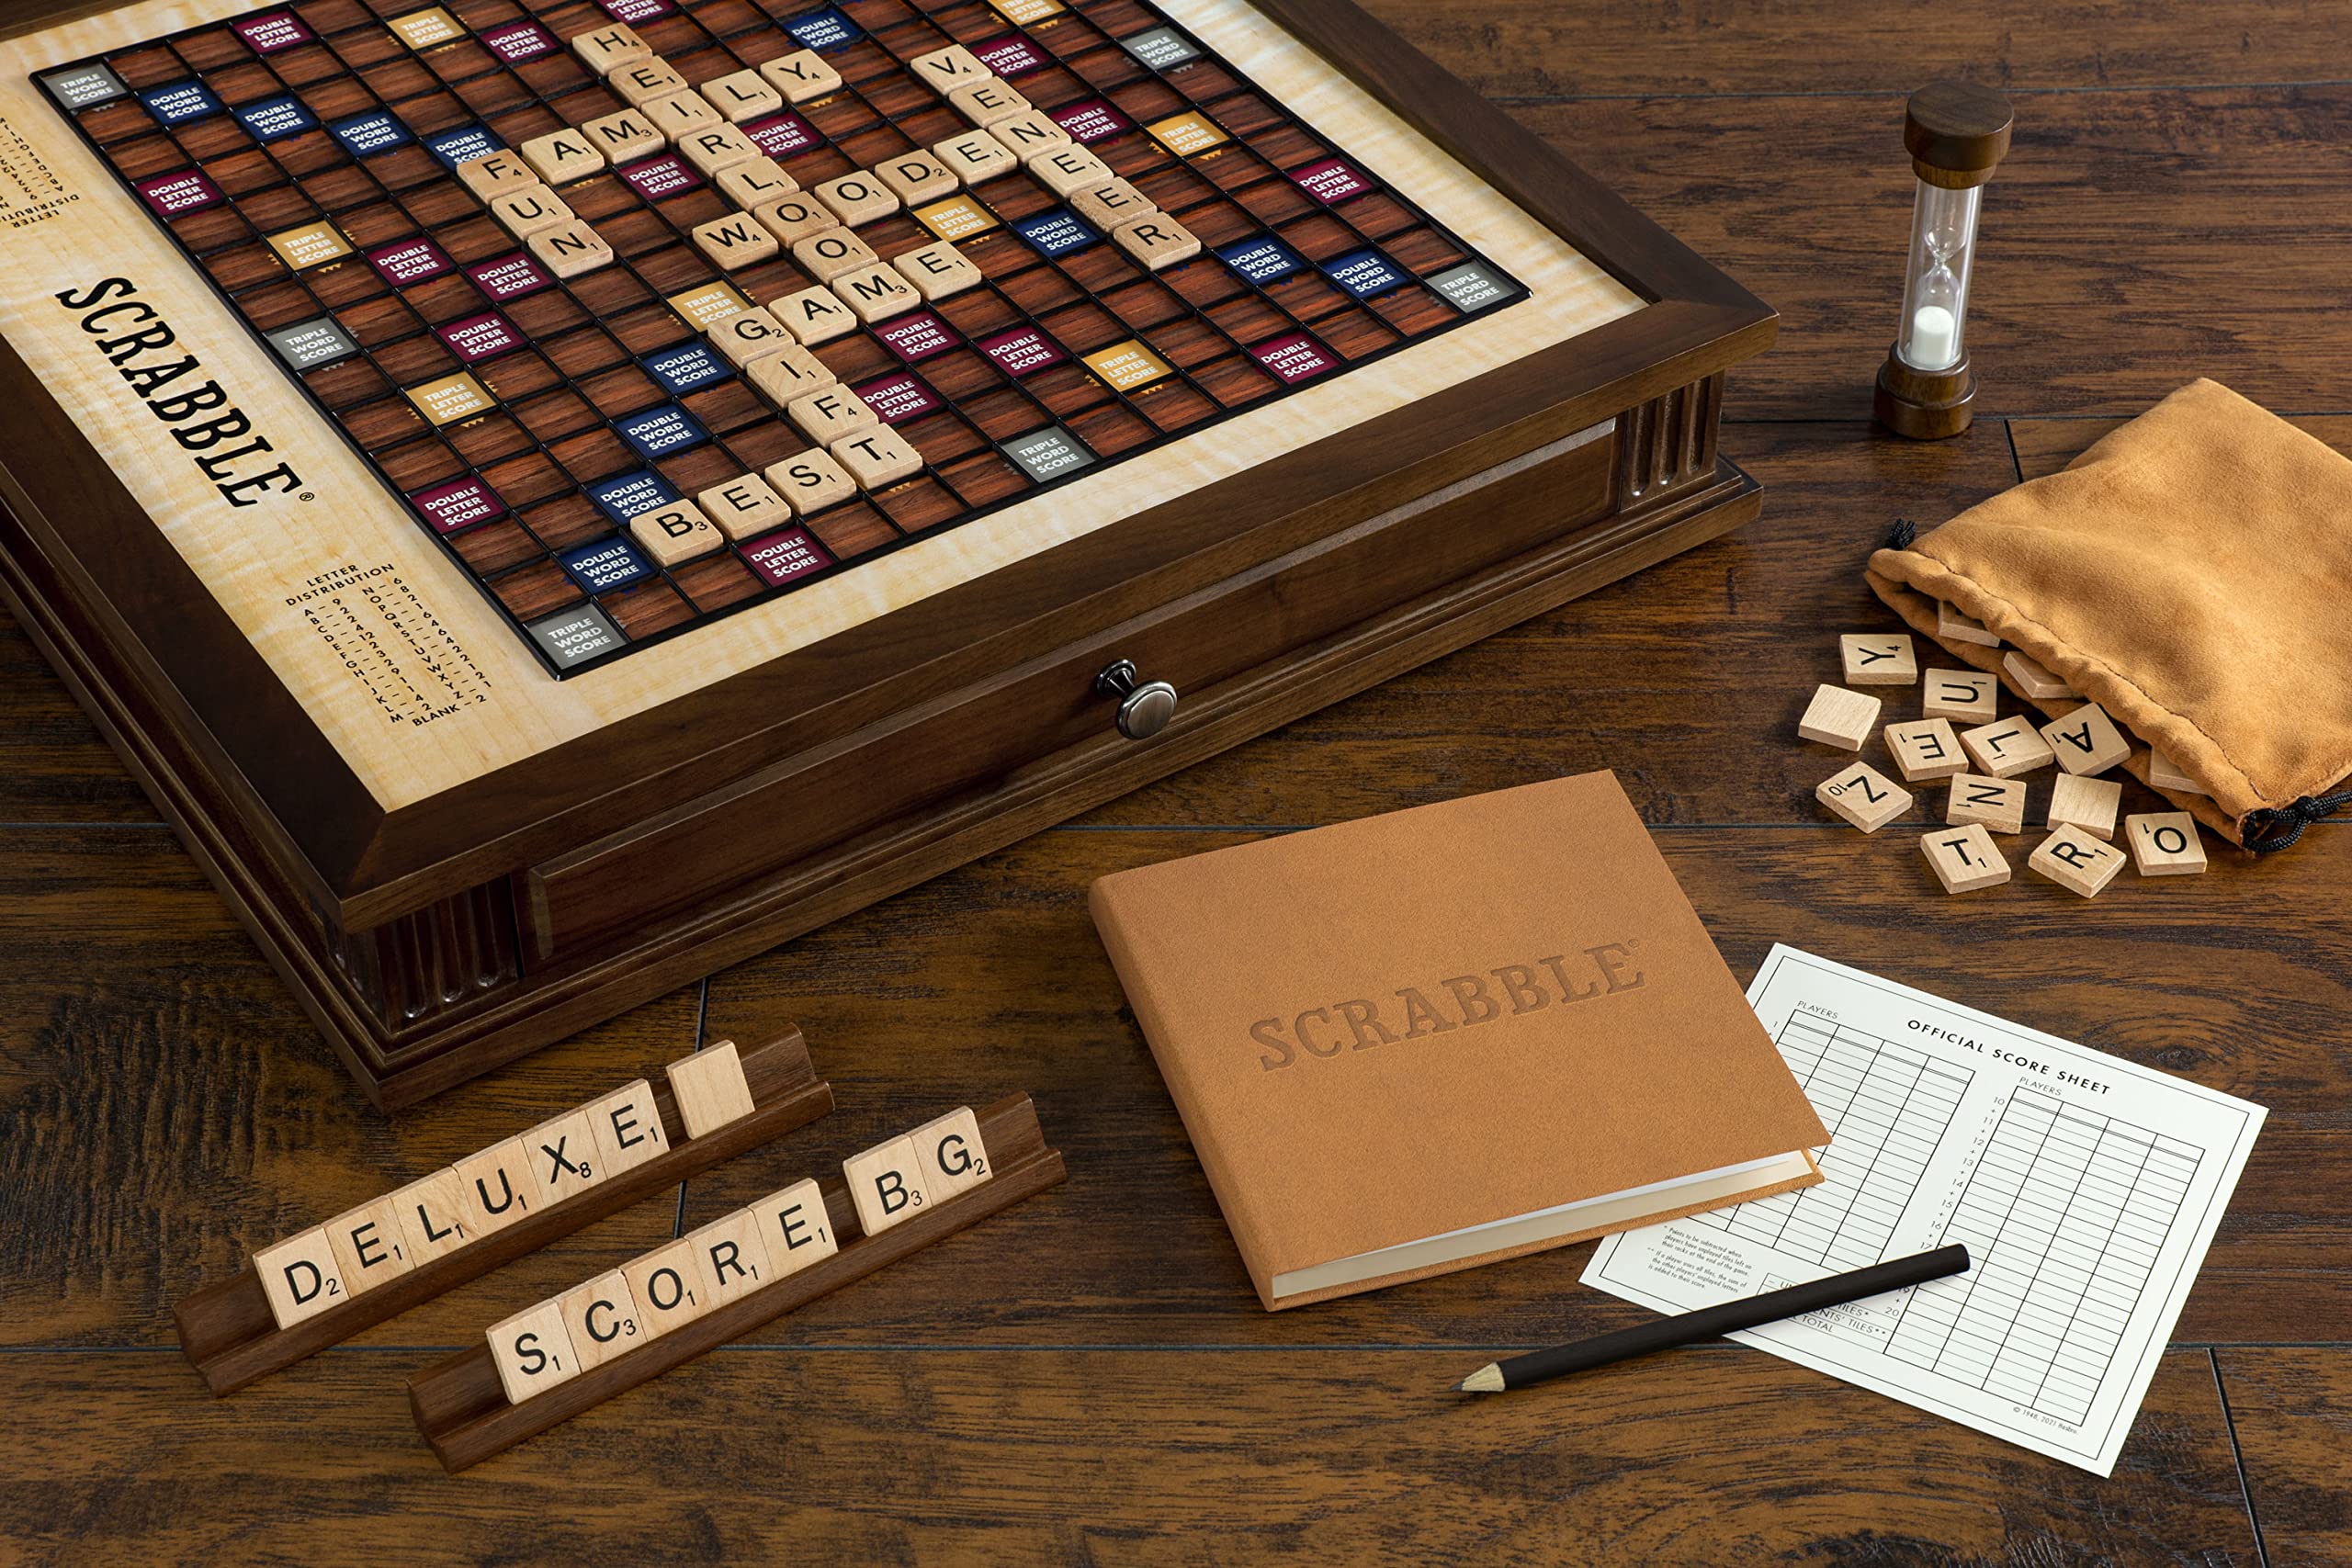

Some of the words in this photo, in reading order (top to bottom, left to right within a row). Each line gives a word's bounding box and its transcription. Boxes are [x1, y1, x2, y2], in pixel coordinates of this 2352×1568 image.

[243, 18, 291, 35] DOUBLE
[254, 26, 294, 40] LETTER
[791, 17, 837, 35] DOUBLE
[802, 25, 841, 39] WORD
[261, 31, 300, 47] SCORE
[810, 31, 848, 47] SCORE
[1135, 36, 1171, 51] TRIPLE
[980, 42, 1025, 62] DOUBLE
[991, 51, 1029, 67] LETTER
[1142, 42, 1180, 58] WORD
[1151, 49, 1188, 65] SCORE
[1000, 56, 1037, 73] SCORE
[60, 74, 100, 88] TRIPLE
[64, 80, 107, 96] WORD
[72, 86, 113, 103] SCORE
[150, 87, 199, 106] DOUBLE
[159, 96, 201, 111] WORD
[166, 102, 209, 118] SCORE
[244, 102, 294, 121] DOUBLE
[254, 111, 296, 127] WORD
[262, 118, 303, 134] SCORE
[1299, 165, 1346, 186] DOUBLE
[1312, 174, 1351, 192] LETTER
[148, 176, 199, 197] DOUBLE
[159, 186, 201, 202] LETTER
[1321, 180, 1360, 198] SCORE
[165, 192, 209, 209] SCORE
[11, 209, 60, 228] LETTER
[930, 205, 968, 221] TRIPLE
[937, 212, 977, 230] LETTER
[945, 219, 986, 236] SCORE
[378, 244, 429, 265] DOUBLE
[389, 254, 431, 271] LETTER
[396, 260, 439, 278] SCORE
[477, 259, 528, 280] DOUBLE
[1332, 257, 1379, 278] DOUBLE
[1344, 266, 1385, 285] WORD
[489, 268, 531, 287] LETTER
[496, 275, 538, 294] SCORE
[1354, 273, 1395, 292] SCORE
[1441, 272, 1479, 290] TRIPLE
[1449, 279, 1489, 298] WORD
[1460, 287, 1499, 305] SCORE
[286, 328, 328, 345] TRIPLE
[291, 335, 335, 353] WORD
[300, 343, 343, 361] SCORE
[653, 349, 707, 371] DOUBLE
[665, 358, 708, 378] WORD
[674, 366, 718, 385] SCORE
[424, 383, 467, 401] TRIPLE
[431, 391, 474, 410] LETTER
[863, 380, 914, 403] DOUBLE
[876, 389, 919, 409] LETTER
[438, 399, 482, 418] SCORE
[885, 397, 927, 417] SCORE
[628, 412, 681, 435] DOUBLE
[639, 422, 684, 441] WORD
[649, 429, 692, 450] SCORE
[1018, 437, 1060, 457] TRIPLE
[1025, 446, 1069, 465] WORD
[1036, 453, 1080, 473] SCORE
[424, 486, 480, 510] DOUBLE
[437, 496, 483, 517] LETTER
[445, 504, 491, 525] SCORE
[571, 546, 628, 570] DOUBLE
[751, 536, 805, 561] DOUBLE
[763, 547, 809, 569] LETTER
[306, 564, 358, 586] LETTER
[583, 557, 630, 577] WORD
[594, 564, 639, 586] SCORE
[773, 555, 818, 577] SCORE
[285, 563, 394, 605] DISTRIBUTION
[548, 617, 594, 638] TRIPLE
[554, 626, 602, 648] WORD
[564, 635, 611, 658] SCORE
[412, 704, 460, 726] BLANK
[475, 694, 486, 703] 2
[1797, 1000, 1838, 1019] PLAYERS
[1907, 1020, 1983, 1053] OFFICIAL
[1992, 1049, 2049, 1075] SCORE
[2056, 1070, 2109, 1094] SHEET
[2018, 1076, 2062, 1095] PLAYERS
[1802, 1314, 1833, 1332] TOTAL
